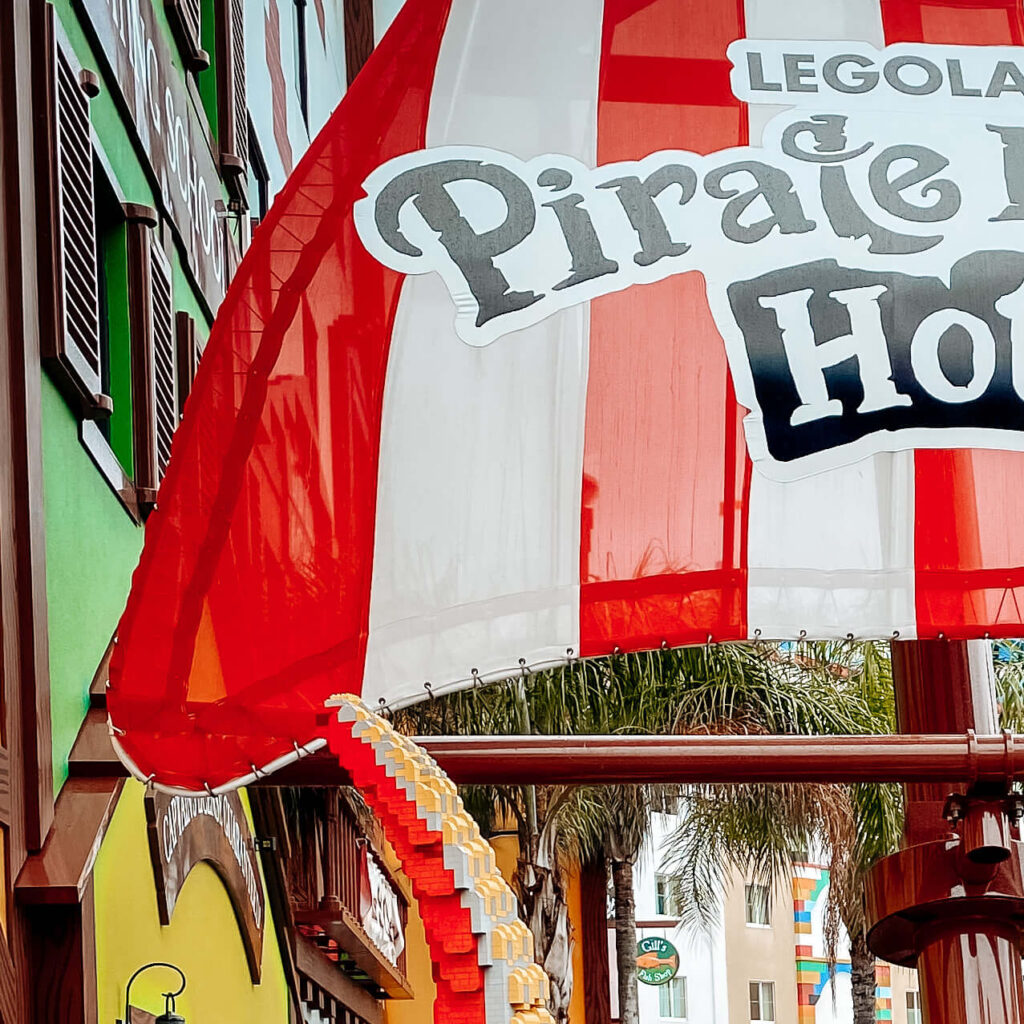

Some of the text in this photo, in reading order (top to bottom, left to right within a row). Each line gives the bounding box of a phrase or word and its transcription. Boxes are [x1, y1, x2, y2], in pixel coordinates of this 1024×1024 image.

[165, 86, 228, 298] SCHOOL
[375, 114, 961, 327] Pirate
[641, 940, 667, 952] Gill's
